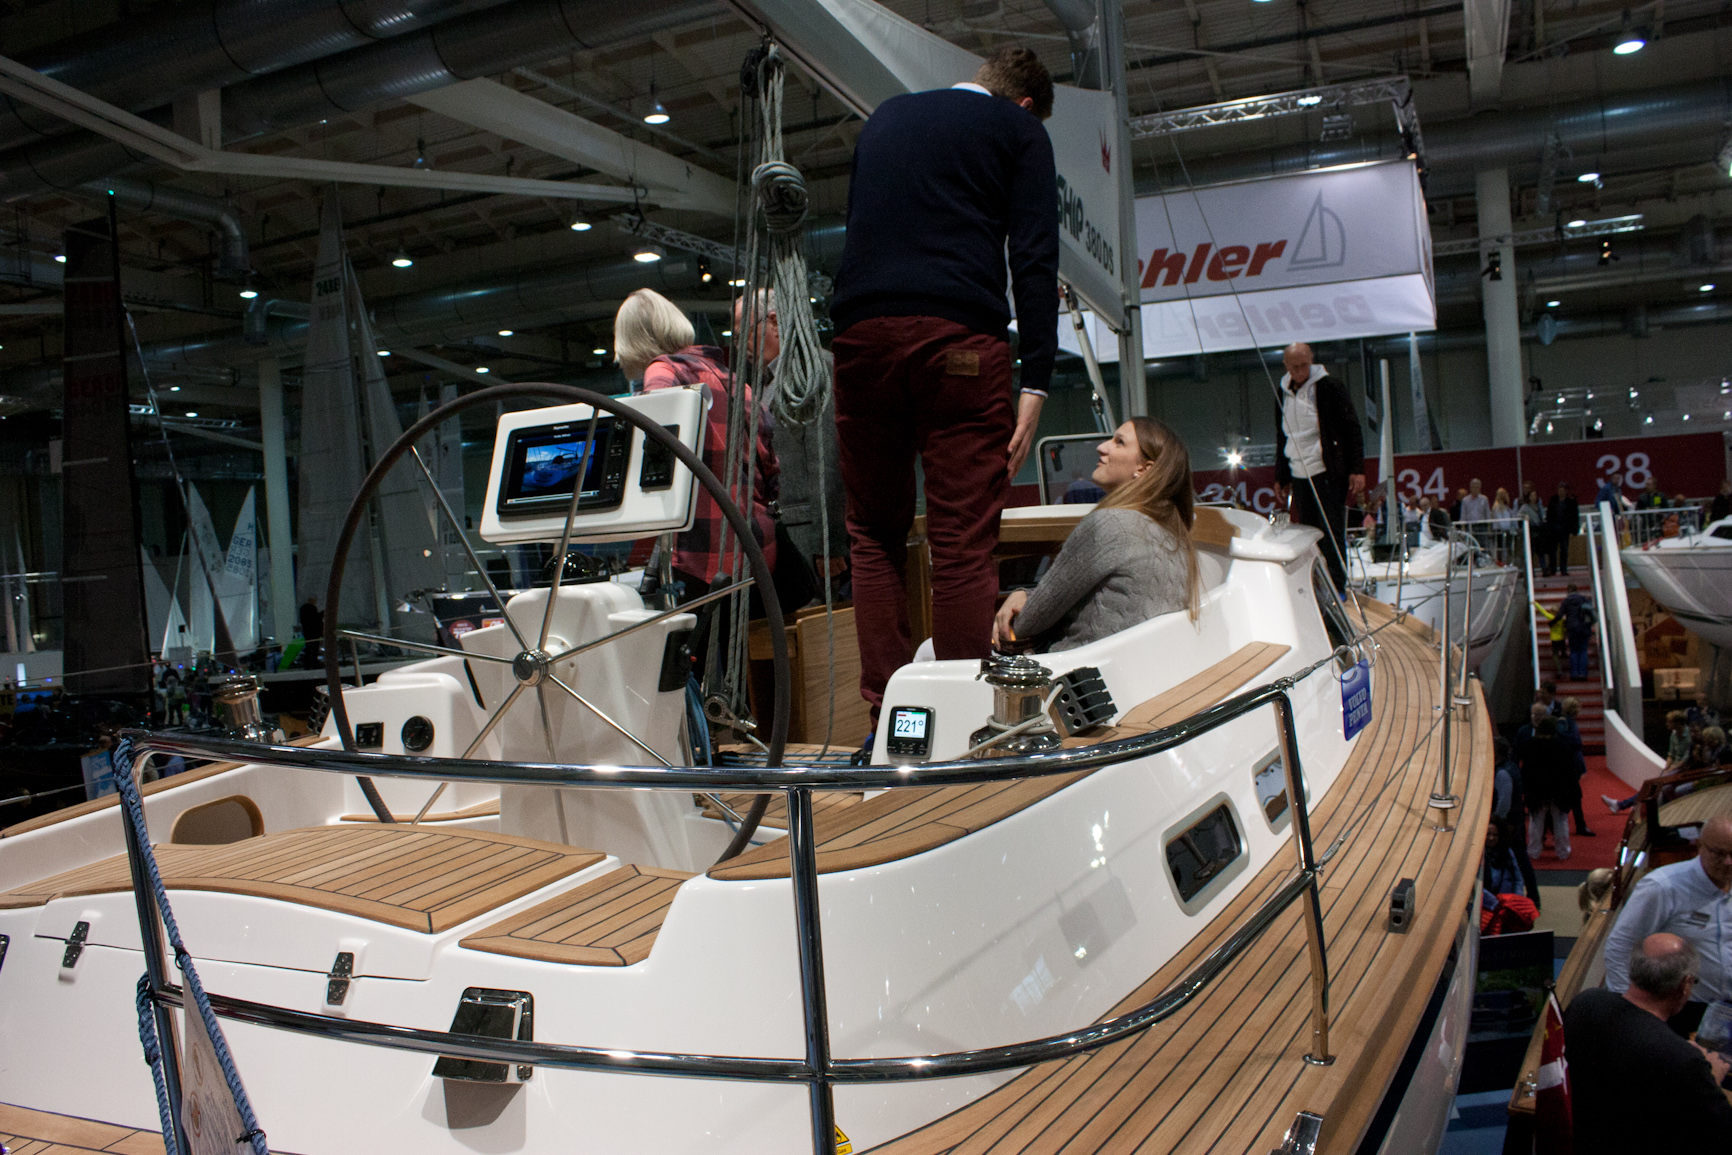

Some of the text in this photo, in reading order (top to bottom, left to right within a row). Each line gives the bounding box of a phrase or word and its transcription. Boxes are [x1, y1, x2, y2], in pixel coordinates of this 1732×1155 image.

[1138, 240, 1287, 289] hler
[1397, 466, 1449, 503] 34
[1596, 452, 1652, 489] 38
[233, 536, 252, 548] GER
[1348, 687, 1367, 711] VOLVO
[1348, 701, 1368, 728] PENTA
